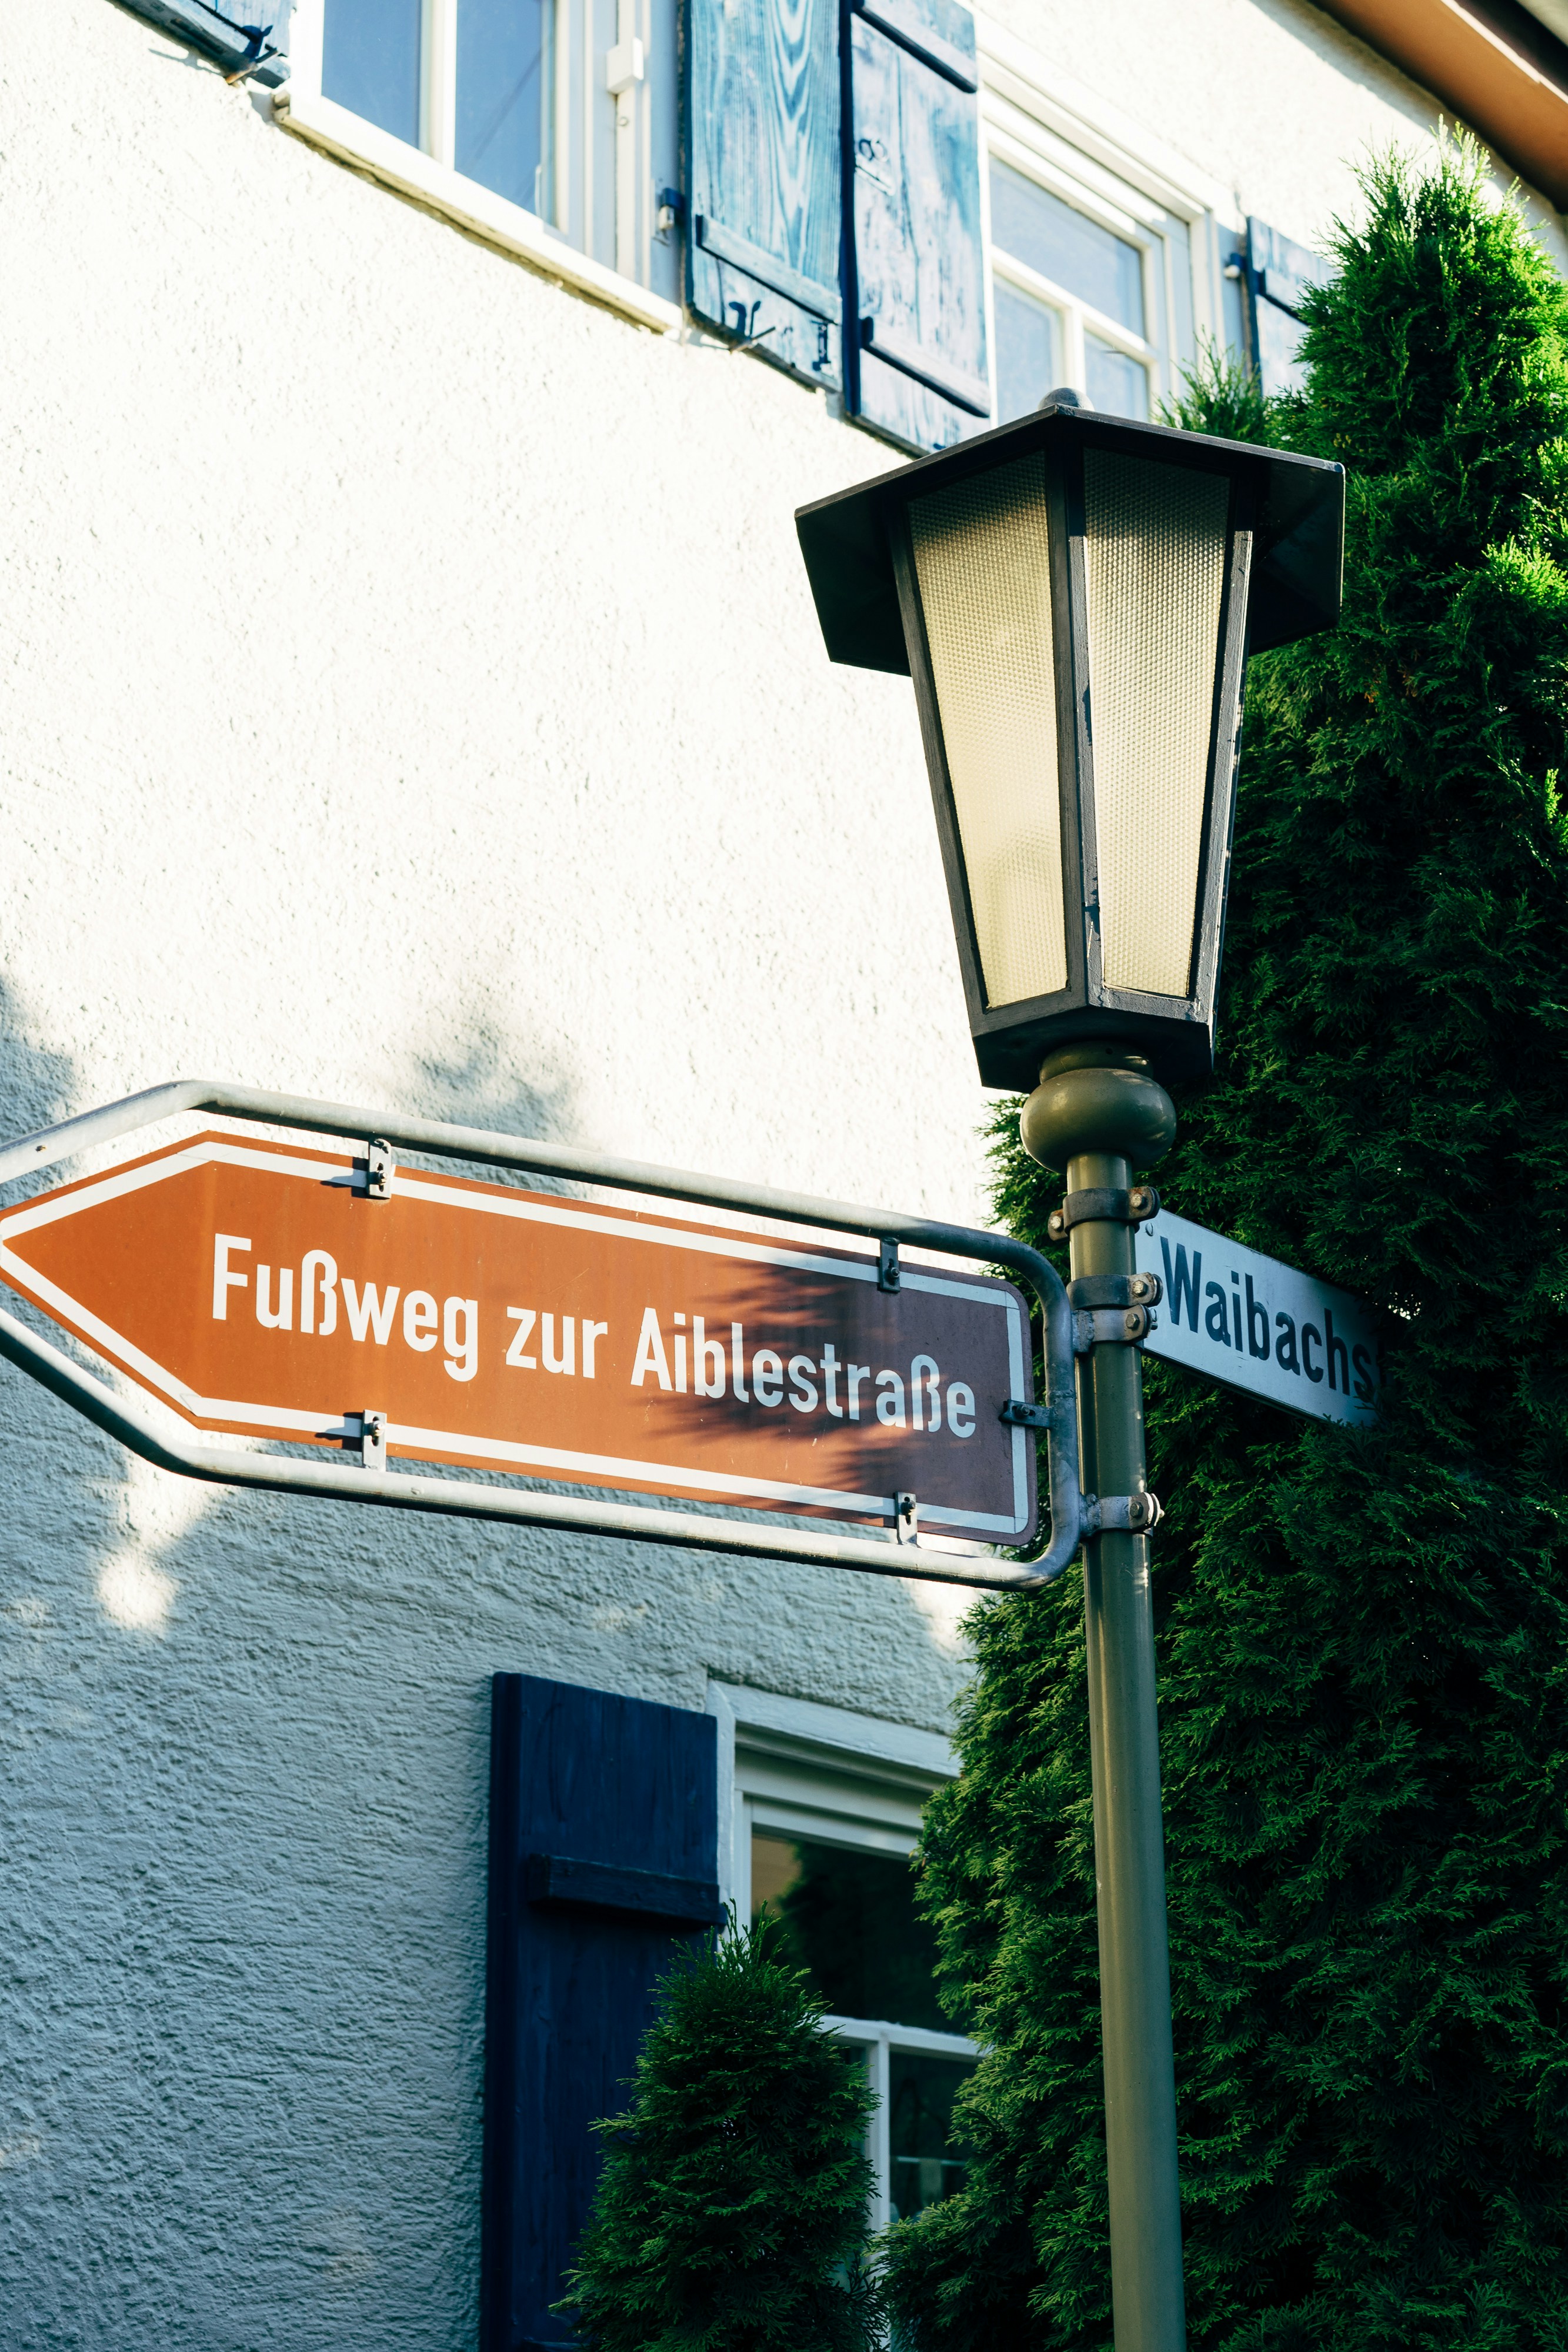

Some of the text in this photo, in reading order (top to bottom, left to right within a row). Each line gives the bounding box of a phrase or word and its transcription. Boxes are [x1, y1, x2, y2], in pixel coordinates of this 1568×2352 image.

[212, 1233, 976, 1438] Fußweg zur Aiblestraße
